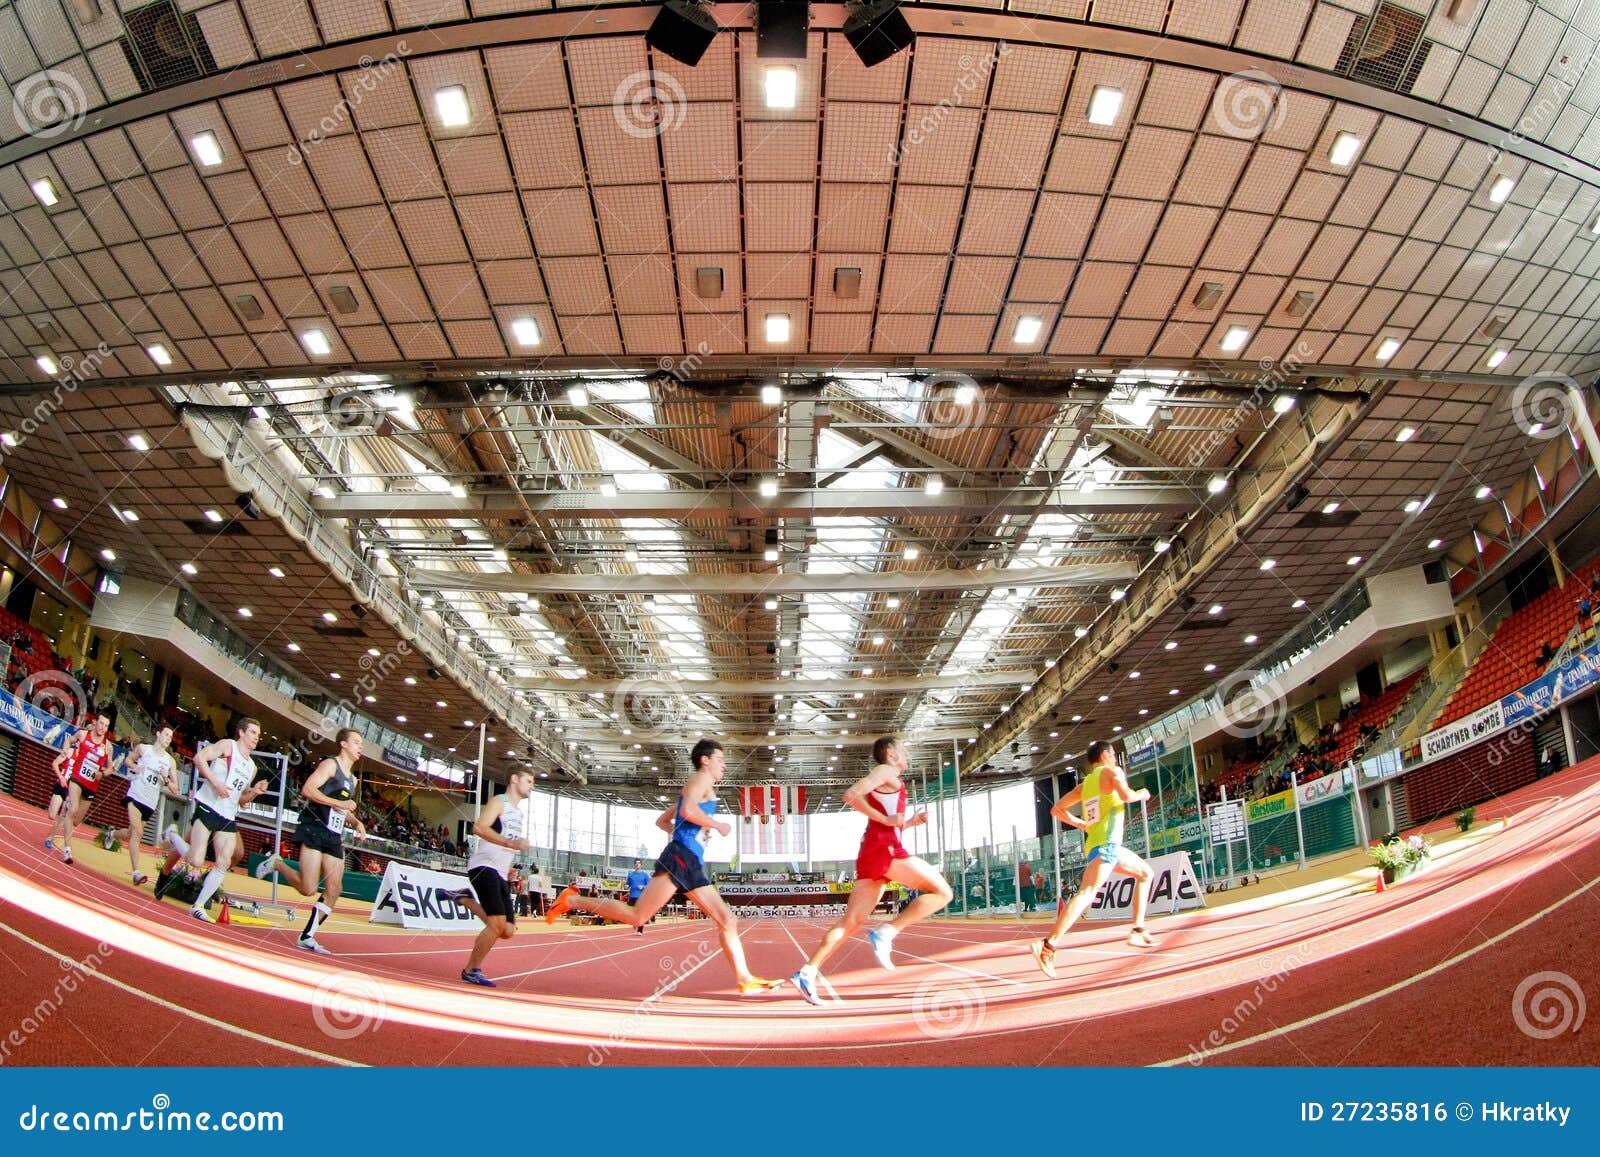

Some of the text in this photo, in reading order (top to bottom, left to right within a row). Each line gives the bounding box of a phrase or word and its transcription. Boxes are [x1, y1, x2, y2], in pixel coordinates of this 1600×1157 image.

[1427, 727, 1471, 756] SCHARTNER
[1472, 711, 1501, 737] BOMBE
[146, 774, 158, 786] 49
[397, 873, 475, 920] ŠKOD
